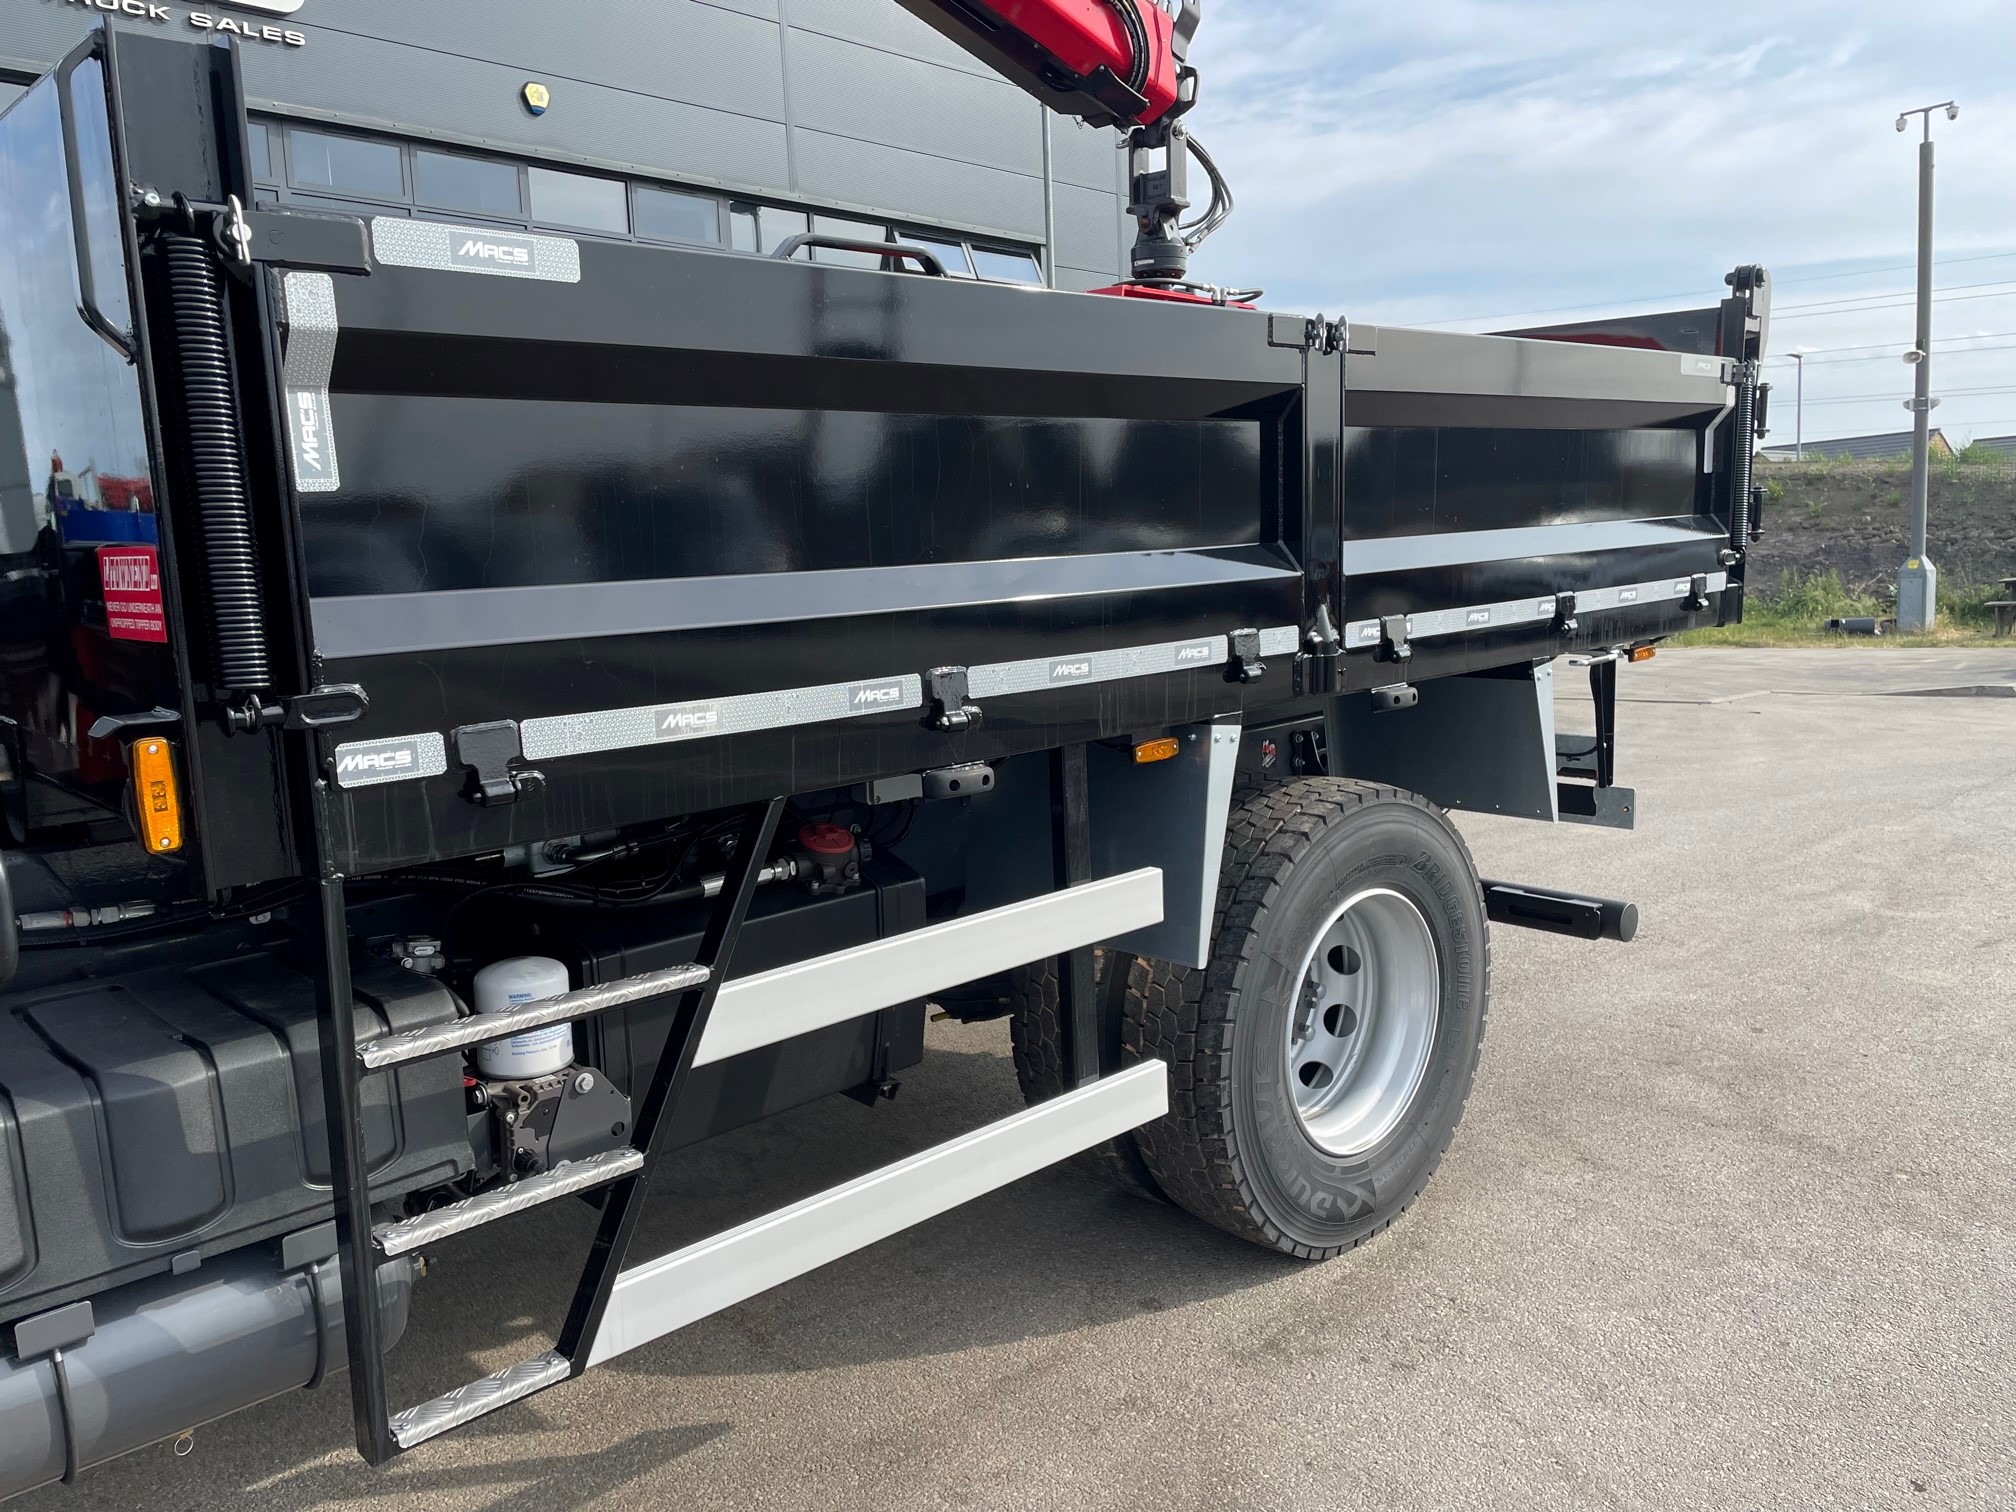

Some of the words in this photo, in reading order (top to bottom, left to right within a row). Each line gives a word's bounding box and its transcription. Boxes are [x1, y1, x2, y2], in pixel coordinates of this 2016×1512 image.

[69, 0, 171, 21] UCK
[190, 11, 306, 46] SALES
[1410, 850, 1471, 1011] BRIDGESTONE
